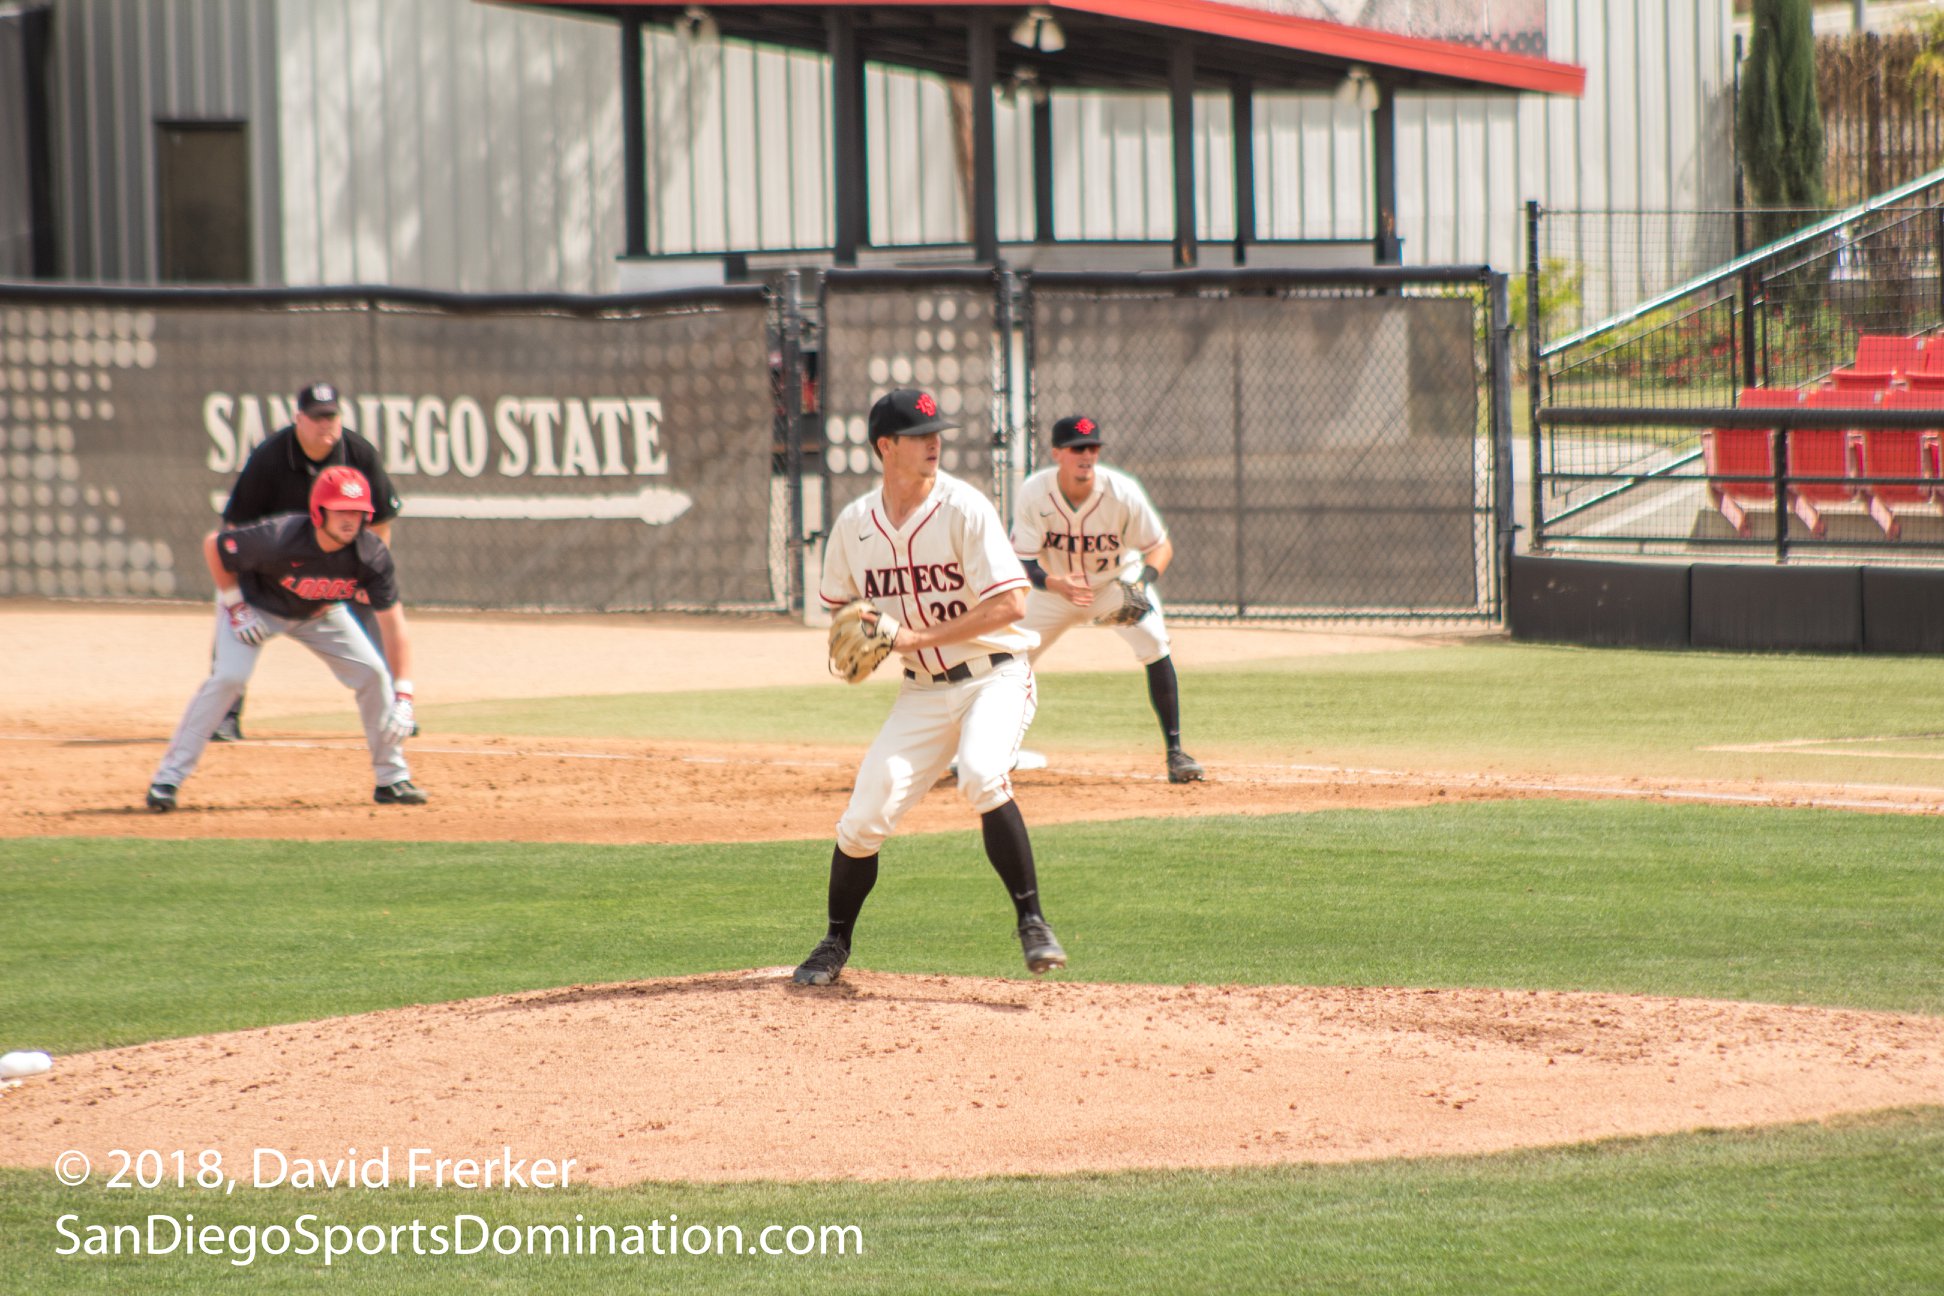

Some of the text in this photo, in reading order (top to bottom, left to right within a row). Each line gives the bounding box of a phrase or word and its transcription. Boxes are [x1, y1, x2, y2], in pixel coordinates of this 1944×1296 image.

[339, 394, 488, 477] IEGO
[494, 395, 668, 477] STATE
[1043, 530, 1120, 553] AZTECS
[864, 562, 965, 599] AZTECS
